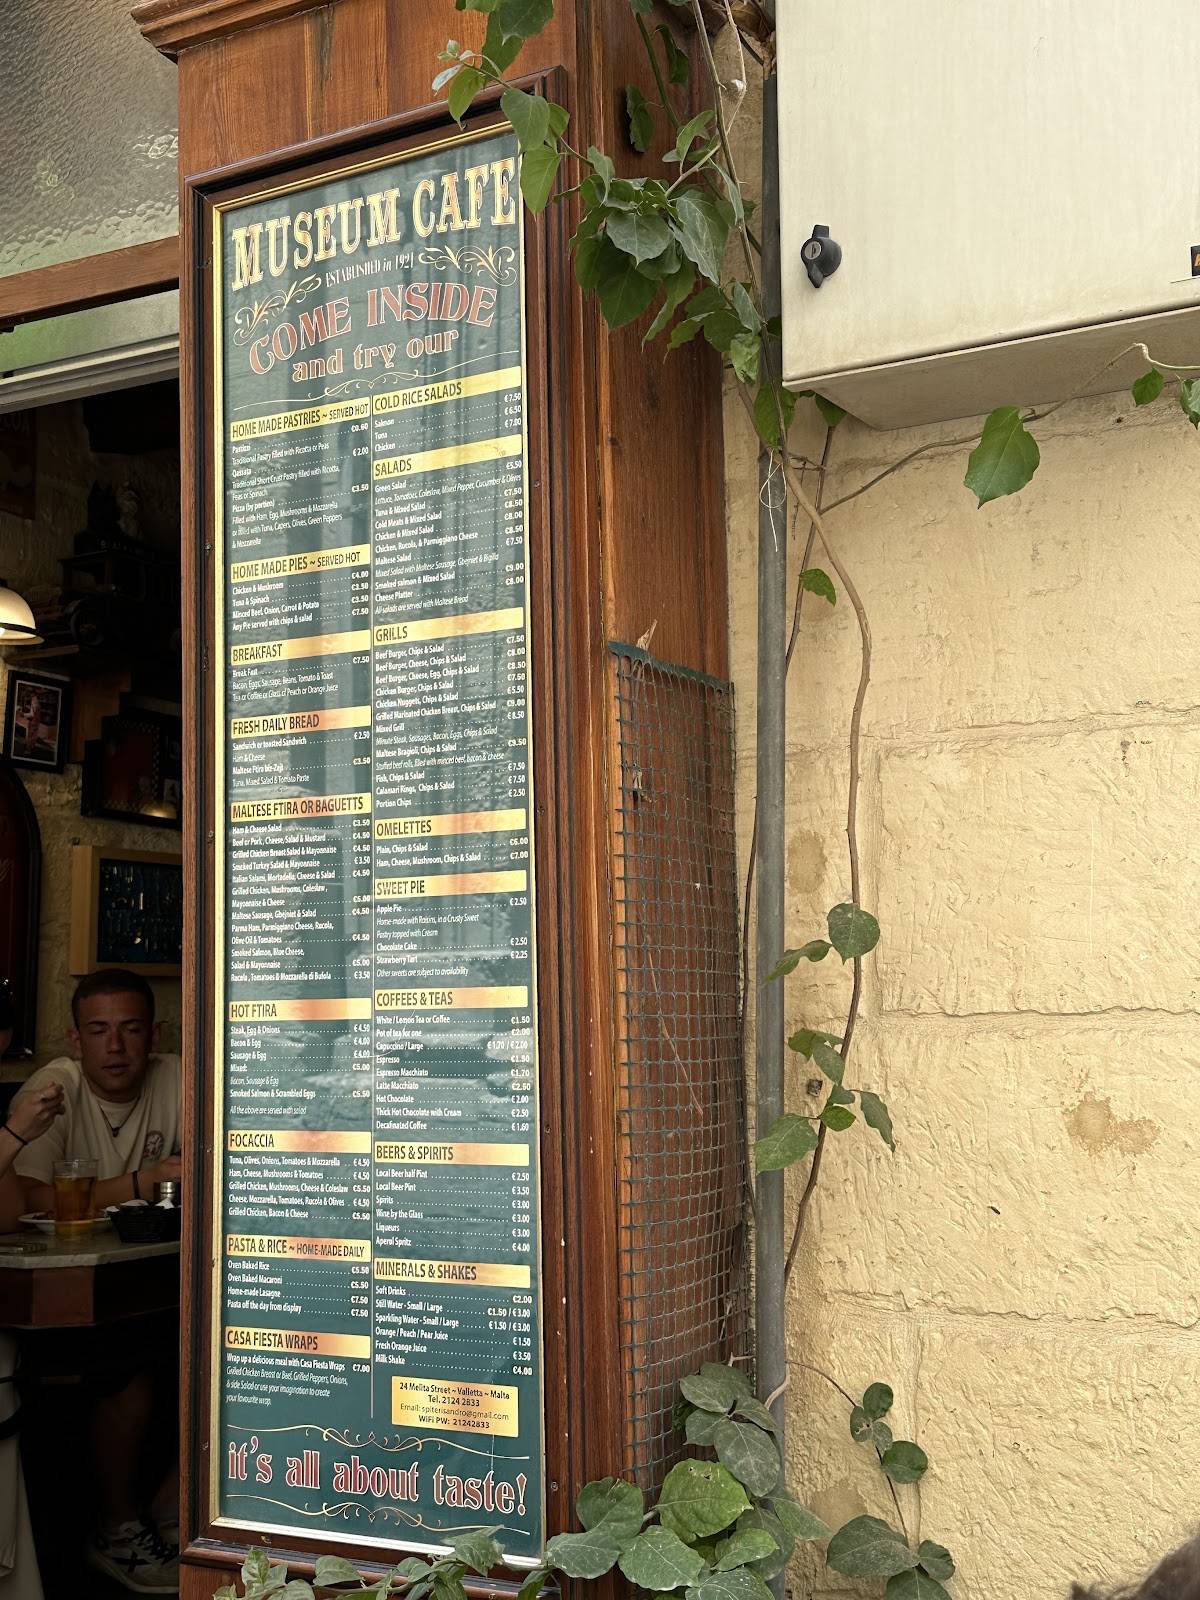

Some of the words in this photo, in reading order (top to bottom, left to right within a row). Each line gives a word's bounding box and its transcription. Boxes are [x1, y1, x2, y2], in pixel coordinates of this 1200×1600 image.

[232, 188, 400, 291] MUSEUM
[412, 157, 516, 238] CAFE
[326, 260, 380, 288] ESTABLISHED
[383, 257, 391, 271] in
[395, 252, 414, 270] 1921
[250, 297, 351, 375] COME
[367, 282, 497, 327] INSIDE
[293, 349, 343, 382] and
[354, 343, 395, 369] try
[407, 330, 458, 359] our
[374, 394, 399, 411] COLD
[402, 389, 422, 406] RICE
[424, 381, 461, 401] SALADS
[232, 421, 255, 438] HOME
[258, 416, 281, 433] MADE
[283, 409, 320, 429] PASTRIES
[329, 406, 352, 420] SERVED
[354, 403, 368, 415] HOT
[375, 441, 395, 452] Chicken
[375, 458, 411, 476] SALADS
[375, 483, 390, 493] Green
[391, 480, 406, 490] Salad
[232, 563, 258, 580] HOME
[261, 559, 286, 575] MADE
[289, 556, 307, 571] PIES
[317, 553, 343, 567] SERVED
[345, 551, 360, 563] HOT
[376, 625, 407, 642] GRILLS
[233, 643, 282, 662] BREAKFAST
[233, 720, 259, 734] FRESH
[262, 717, 287, 732] DAILY
[289, 714, 319, 729] BREAD
[375, 724, 392, 733] Mixed
[393, 722, 404, 731] Grill
[233, 802, 270, 818] MALTESE
[273, 801, 298, 815] FTIRA
[300, 800, 313, 814] OR
[316, 795, 363, 813] BAGUETTS
[376, 819, 431, 836] OMELETTES
[392, 844, 405, 854] Chips
[413, 843, 428, 851] Salad
[376, 881, 408, 895] SWEET
[410, 880, 424, 893] PIE
[376, 905, 392, 914] Apple
[393, 904, 401, 912] Pie
[376, 943, 402, 951] Chocolate
[404, 942, 416, 950] Cake
[376, 992, 417, 1006] COFFEES
[420, 992, 426, 1005] &
[428, 992, 452, 1005] TEAS
[231, 1004, 249, 1017] HOT
[252, 1003, 276, 1017] FTIRA
[251, 1039, 261, 1047] Egg
[230, 1133, 274, 1147] FOCACCIA
[376, 1145, 405, 1159] BEERS
[408, 1146, 415, 1159] &
[417, 1146, 453, 1160] SPIRITS
[391, 1169, 404, 1177] Beer
[376, 1182, 390, 1190] Local
[376, 1195, 393, 1204] Spirits
[376, 1209, 389, 1217] Wine
[390, 1209, 397, 1218] by
[408, 1210, 423, 1218] Glass
[228, 1238, 255, 1252] PASTA
[258, 1238, 264, 1252] &
[267, 1239, 286, 1253] RICE
[296, 1243, 341, 1256] HOME-MADE
[343, 1245, 364, 1257] DAILY
[376, 1236, 394, 1246] Aperol
[395, 1237, 411, 1247] Spritz
[228, 1260, 241, 1268] Oven
[242, 1260, 257, 1269] Baked
[258, 1261, 269, 1270] Rice
[376, 1261, 425, 1277] MINERALS
[428, 1264, 434, 1278] &
[437, 1264, 476, 1280] SHAKES
[376, 1286, 387, 1294] Soft
[388, 1287, 405, 1295] Drinks
[227, 1330, 250, 1345] CASA
[253, 1331, 282, 1347] FIESTA
[285, 1334, 317, 1350] WRAPS
[375, 1340, 390, 1349] Fresh
[391, 1342, 410, 1353] Orange
[412, 1343, 426, 1352] Juice
[227, 1353, 239, 1363] Wrap
[252, 1355, 274, 1364] delicious
[275, 1356, 287, 1365] meal
[288, 1358, 299, 1366] with
[300, 1359, 312, 1368] Casa
[313, 1360, 327, 1369] Fiesta
[328, 1361, 344, 1371] Wraps
[375, 1354, 387, 1363] Milk
[388, 1355, 405, 1364] Shake
[400, 1382, 407, 1390] 24
[430, 1385, 450, 1394] Street
[457, 1387, 482, 1396] Valletta
[490, 1390, 509, 1399] Malta
[400, 1403, 420, 1411] Email:
[428, 1394, 439, 1402] Tel.
[442, 1396, 459, 1404] 2124
[462, 1398, 479, 1406] 2833
[419, 1415, 434, 1423] WiFi
[452, 1418, 489, 1428] 21242833
[228, 1436, 273, 1484] it's
[286, 1451, 320, 1489] all
[334, 1456, 419, 1501] about
[433, 1464, 527, 1516] taste!
